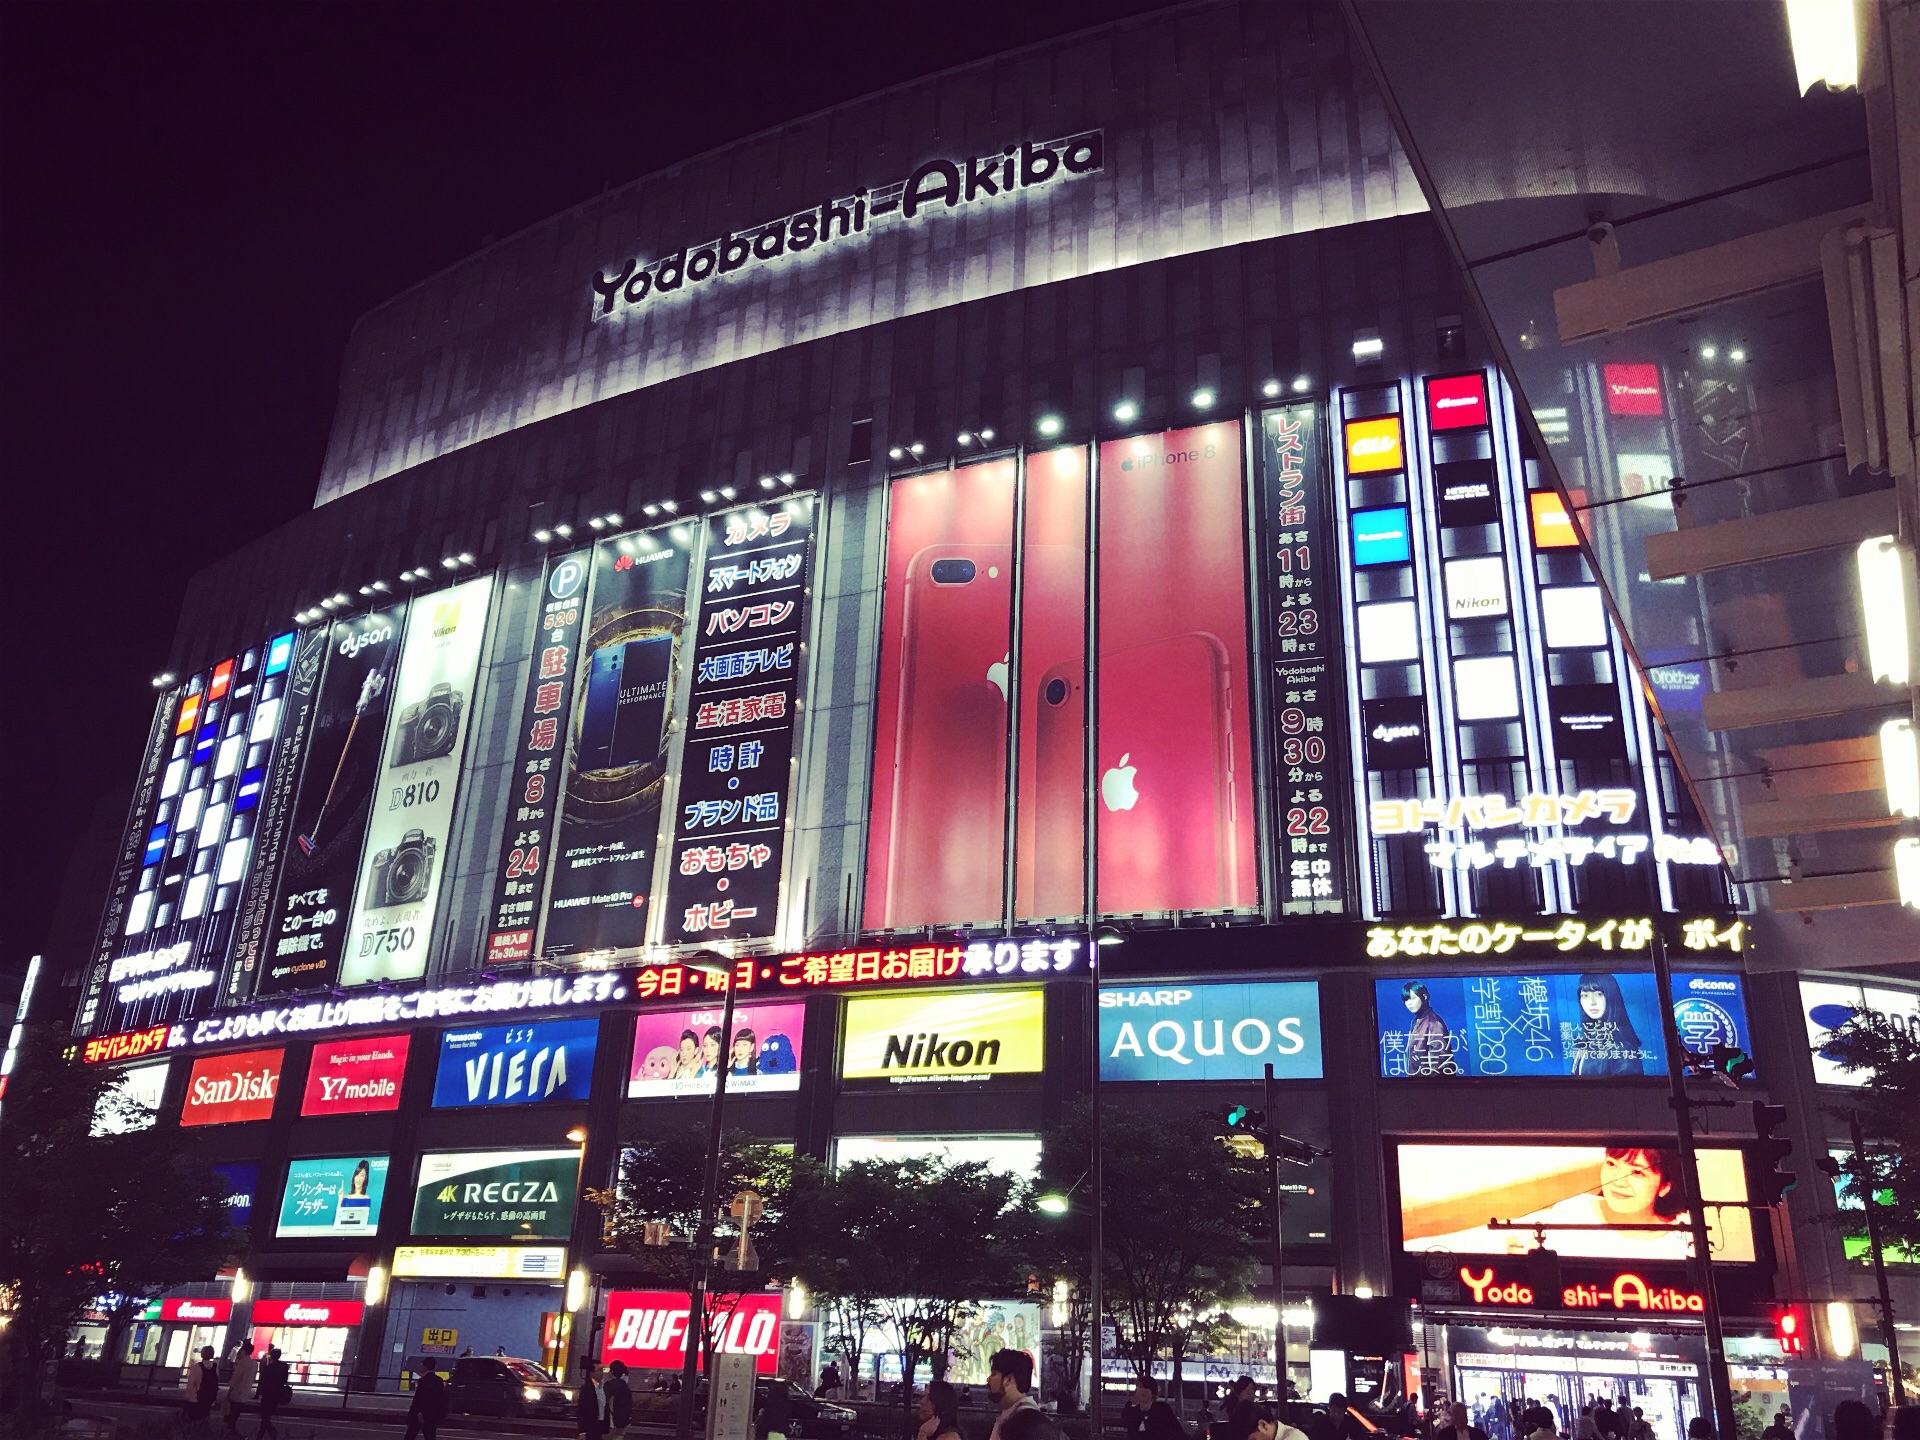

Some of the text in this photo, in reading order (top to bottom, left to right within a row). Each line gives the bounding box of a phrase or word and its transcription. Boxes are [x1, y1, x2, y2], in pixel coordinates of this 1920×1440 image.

[592, 135, 1102, 314] Yodobashi-Akiba
[1137, 445, 1216, 470] iPhone 8
[1277, 418, 1306, 527] レストラン街
[723, 511, 791, 547] カメラ
[1278, 531, 1309, 544] あさ
[635, 549, 674, 566] HUAWEI
[1277, 546, 1311, 572] 11
[707, 553, 802, 593] スマートフォン
[1278, 574, 1313, 589] 時から
[1281, 593, 1313, 608] よる
[1455, 597, 1500, 610] Nikon
[543, 608, 577, 630] 520
[705, 600, 795, 637] パソコン
[1278, 609, 1318, 637] 23
[339, 625, 392, 658] dyson
[432, 625, 457, 639] Nikon
[550, 628, 564, 643] 台
[1282, 639, 1316, 653] 時まで
[697, 642, 794, 684] 大画面テレビ
[1275, 664, 1325, 676] Yodobashi
[619, 681, 667, 698] ULTIMATE
[1286, 675, 1316, 685] Akiba
[528, 645, 569, 752] 駐車場
[619, 692, 667, 705] PERFORMANCE
[1286, 689, 1317, 704] あさ
[695, 691, 786, 730] 生活家電
[1281, 707, 1324, 735] 9時
[1372, 724, 1420, 742] dyson
[708, 740, 764, 773] 時計
[1283, 736, 1326, 765] 30
[525, 757, 552, 774] あさ
[1288, 767, 1323, 783] 分から
[389, 780, 440, 811] D810
[524, 774, 546, 804] 8
[1290, 788, 1323, 803] よる
[516, 807, 545, 822] 時から
[685, 792, 779, 830] ブランド品
[1287, 806, 1330, 836] 22
[1371, 789, 1636, 835] ヨドバシカメラ
[514, 830, 541, 847] よる
[1291, 837, 1328, 853] 時まで
[505, 846, 540, 879] 24
[680, 842, 771, 876] おもちゃ
[1424, 835, 1648, 870] マルチメディア
[1290, 858, 1331, 878] 年中
[287, 888, 328, 910] すべてを
[504, 881, 534, 896] 時まで
[554, 896, 590, 909] HUAWEI
[592, 893, 619, 905] Mate10
[620, 891, 633, 902] Pro
[281, 908, 337, 932] この一台の
[682, 899, 757, 932] ホビー
[359, 926, 415, 958] D750
[1366, 918, 1653, 958] あなたのケータイが
[271, 966, 291, 978] dyson
[291, 963, 315, 975] cyclone
[1689, 978, 1736, 990] docomo
[1098, 990, 1193, 1008] SHARP
[446, 1031, 482, 1043] Panasonic
[506, 1028, 534, 1044] ビエラ
[1471, 978, 1508, 1075] 学割280
[881, 1032, 1001, 1069] Nikon
[1109, 1017, 1304, 1064] AQUOS
[329, 1054, 348, 1064] Magic
[349, 1053, 355, 1062] in
[355, 1053, 371, 1063] your
[1383, 1054, 1465, 1076] はじまる。
[466, 1045, 567, 1102] VIERA
[191, 1068, 276, 1106] SanDisk
[293, 1180, 337, 1197] プリンターは
[436, 1182, 559, 1203] 4K REGZA
[443, 1210, 546, 1222] レグザがもたらす、感動の高画質
[283, 1304, 329, 1322] docomo
[428, 1329, 453, 1342] 出口
